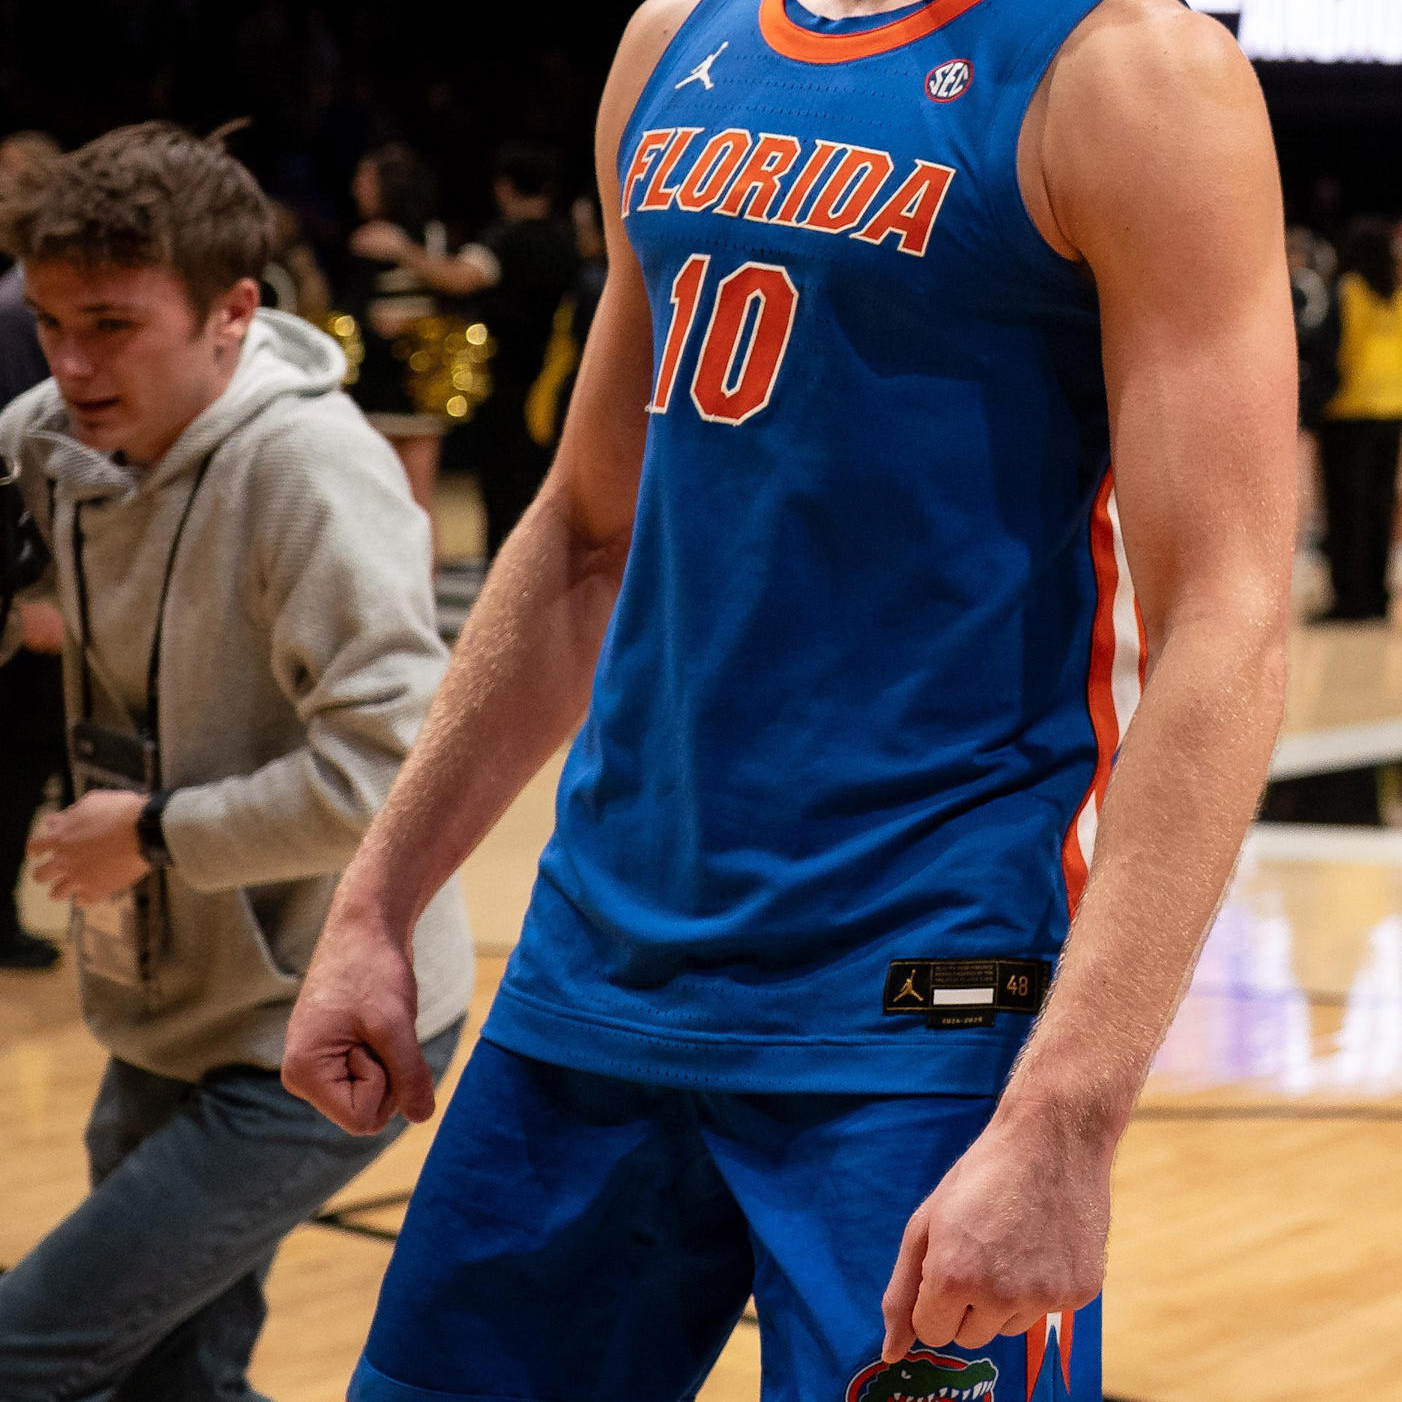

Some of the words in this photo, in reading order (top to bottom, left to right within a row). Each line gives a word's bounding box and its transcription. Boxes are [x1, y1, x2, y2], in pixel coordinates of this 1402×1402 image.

[929, 61, 969, 98] SEC
[621, 127, 957, 257] FLORIDA
[645, 254, 799, 426] 10
[1006, 974, 1029, 997] 48
